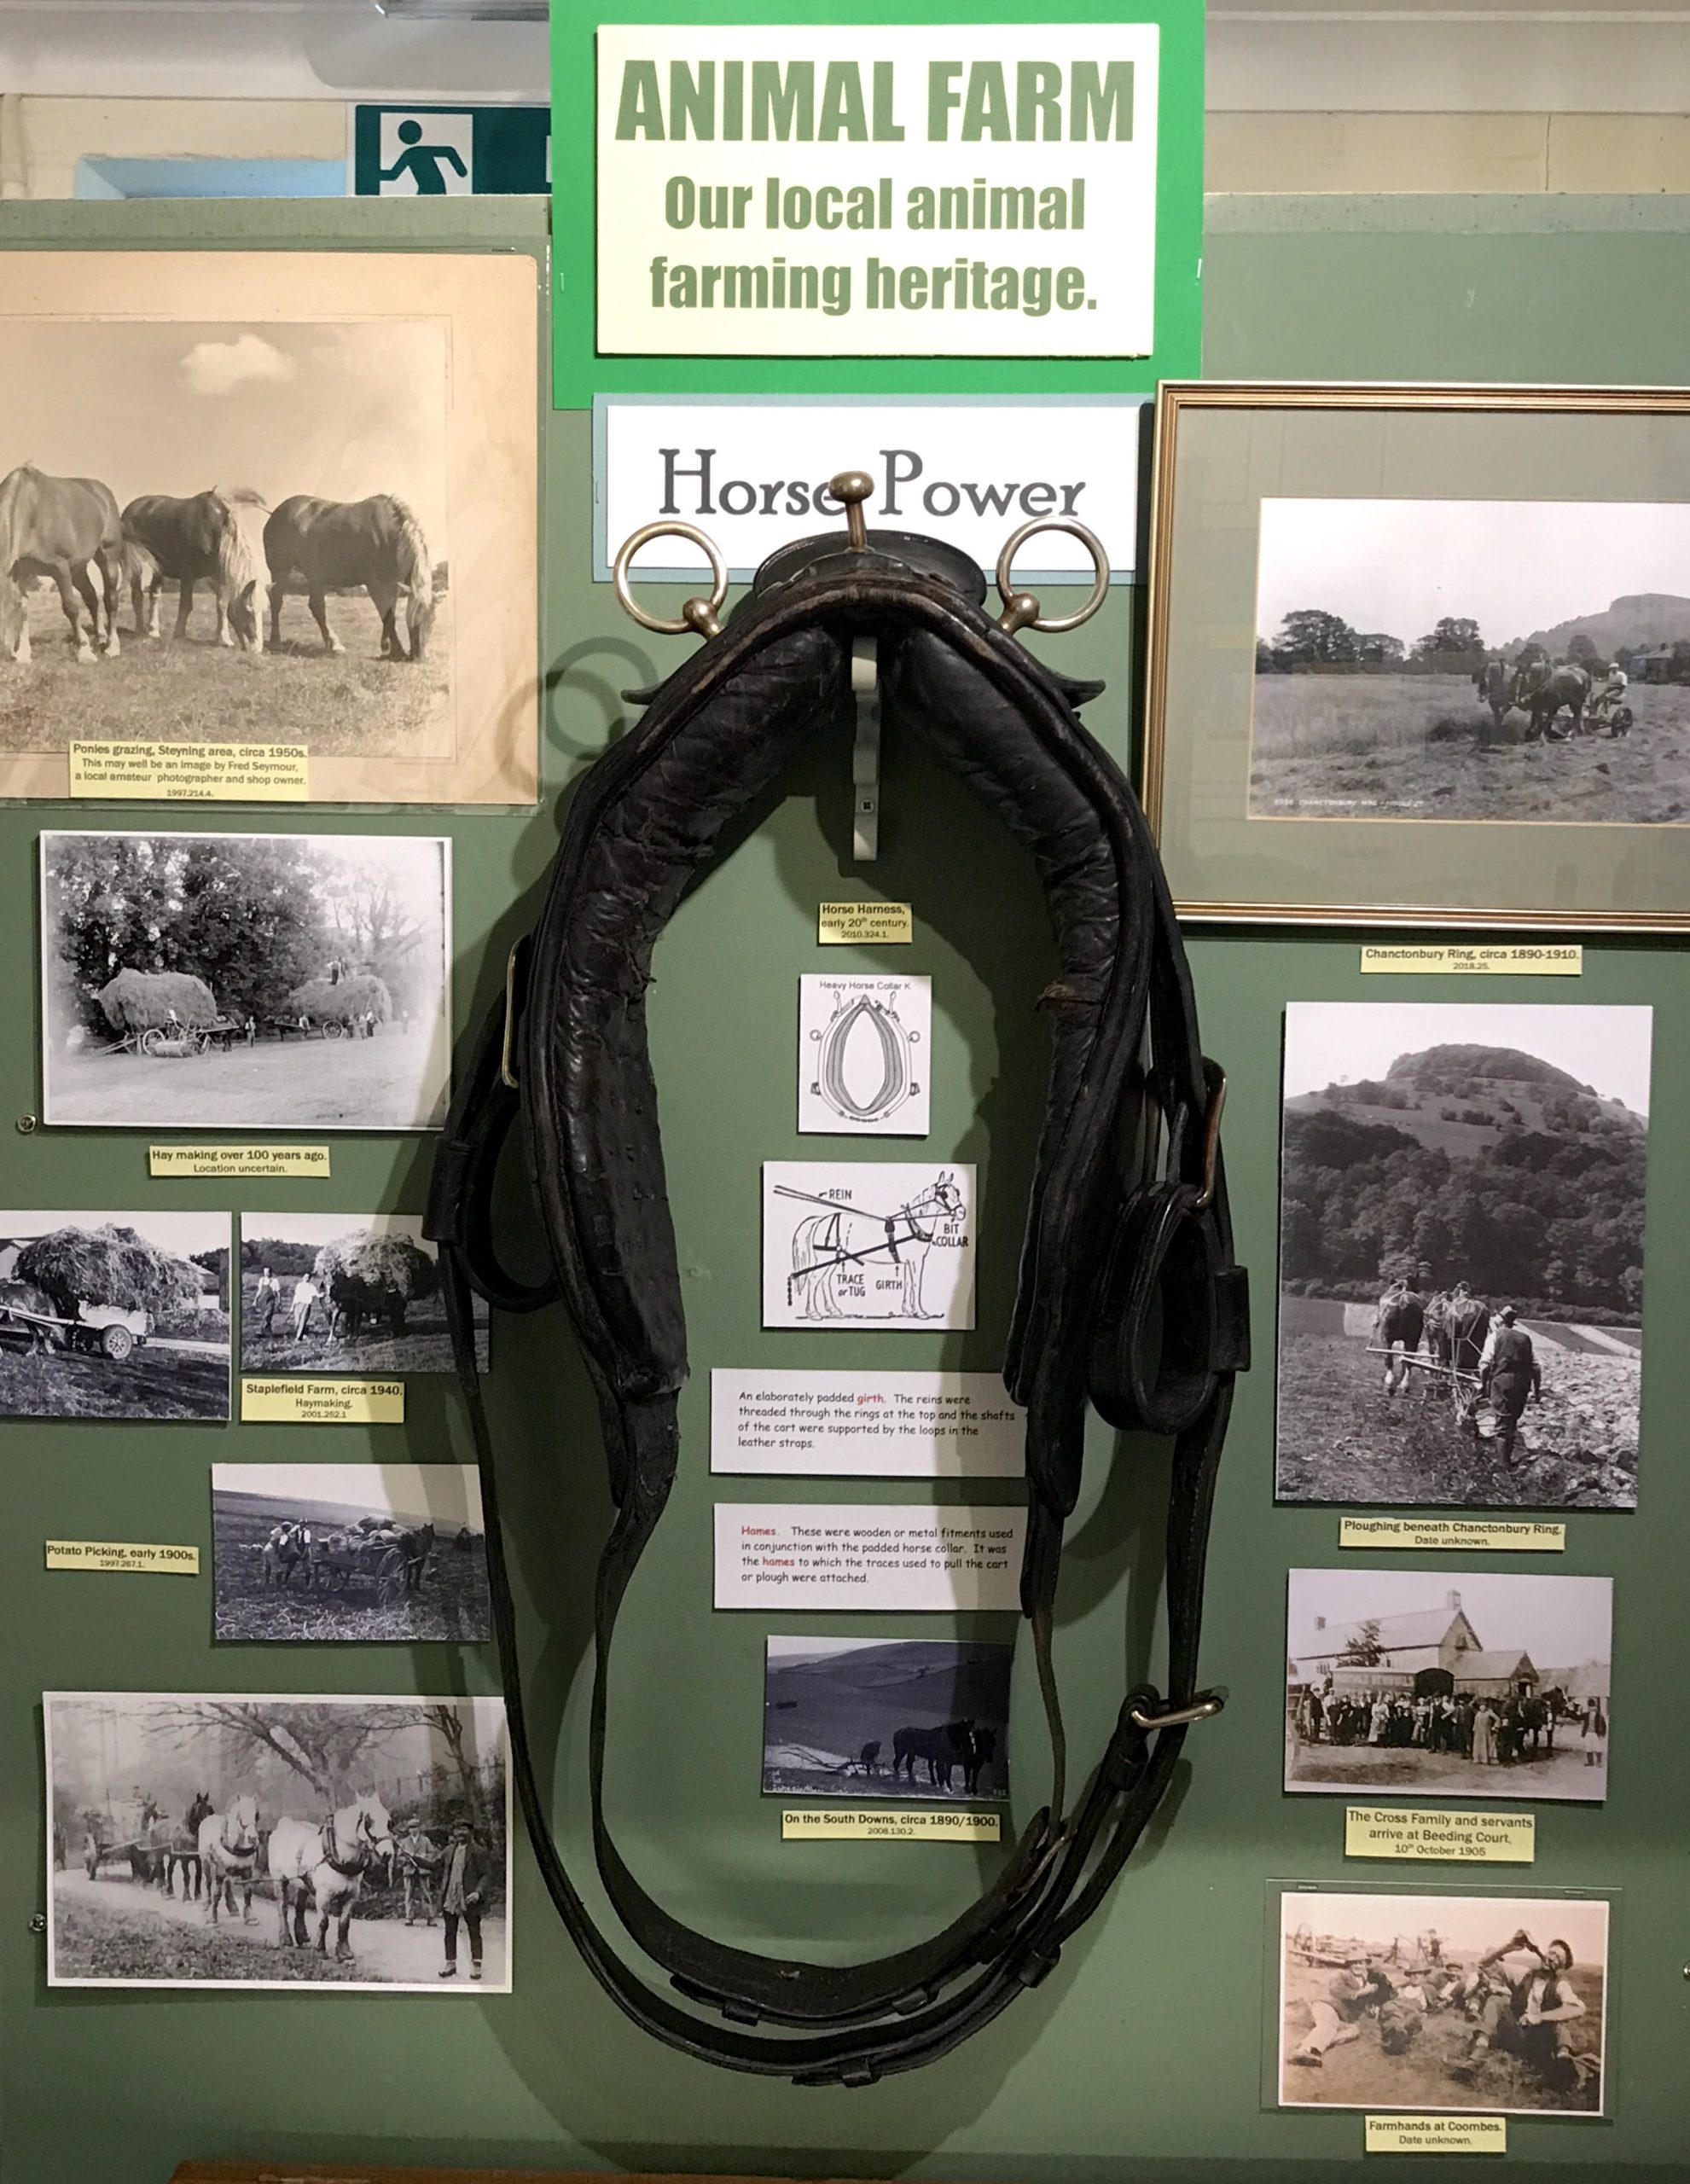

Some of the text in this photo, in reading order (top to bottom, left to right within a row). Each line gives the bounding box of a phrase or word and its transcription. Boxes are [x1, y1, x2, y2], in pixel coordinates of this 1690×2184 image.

[615, 59, 1135, 142] ANIMAL FARM
[664, 175, 1086, 231] Our local animal
[649, 256, 1098, 317] farming heritage.
[659, 448, 1086, 517] Horse Power
[73, 744, 307, 758] Ponies grazing, Steyning area, circa 1950s.
[82, 758, 102, 767] This
[105, 760, 125, 770] may
[128, 759, 148, 768] well
[150, 760, 162, 769] be
[181, 760, 211, 772] image
[214, 761, 225, 772] by
[228, 761, 249, 770] Fred
[252, 762, 298, 773] Seymour,
[84, 772, 107, 781] local
[110, 773, 151, 781] amateur
[157, 774, 223, 784] photographer
[247, 775, 270, 785] shop
[274, 776, 305, 785] owner.
[822, 905, 904, 915] Horse Harness,
[822, 919, 845, 928] early
[1366, 949, 1579, 960] Chanctonbury Ring, circa 1890-1910.
[820, 981, 846, 990] Heavy
[877, 982, 902, 990] Collar
[153, 1150, 171, 1162] Hay
[177, 1150, 218, 1161] making
[247, 1151, 269, 1159] 100
[272, 1152, 301, 1162] years
[305, 1152, 327, 1162] ago.
[194, 1164, 287, 1173] Location uncertain.
[829, 1189, 852, 1199] REIN
[944, 1224, 958, 1234] BIT
[936, 1236, 968, 1247] COLLAR
[837, 1274, 864, 1285] TRACE
[876, 1281, 903, 1290] GIRTH
[850, 1287, 866, 1297] TUG
[247, 1384, 402, 1396] Staplefield Farm, circa 1940.
[296, 1398, 352, 1409] Haymaking.
[739, 1391, 971, 1406] An elaborately padded girth. The reins were
[739, 1407, 1015, 1422] threaded through the rings at the top and the shafts
[738, 1421, 979, 1438] of the cart were supported by the loops in the
[738, 1438, 815, 1450] leather straps.
[741, 1526, 1013, 1538] Hames. These were wooden or metal fitments used
[1344, 1521, 1530, 1535] Ploughing beneath Chanctonbury
[1414, 1536, 1490, 1546] Date unknown.
[47, 1546, 195, 1560] Potato Picking, early 1900s.
[741, 1542, 1007, 1554] in conjunction with the padded horse collar. It was
[742, 1556, 1008, 1571] the hames to which the traces used to pull the cart
[741, 1571, 869, 1584] or plough were attached.
[785, 1815, 998, 1827] On the South Downs, circa 1890/1900.
[1349, 1810, 1532, 1828] The Cross Family and servants
[1369, 1829, 1472, 1843] arrive at Beeding
[1417, 1845, 1486, 1856] October 1905
[1369, 2121, 1502, 2131] Farmhands at Coombes.
[1399, 2135, 1472, 2145] Date unknown.
